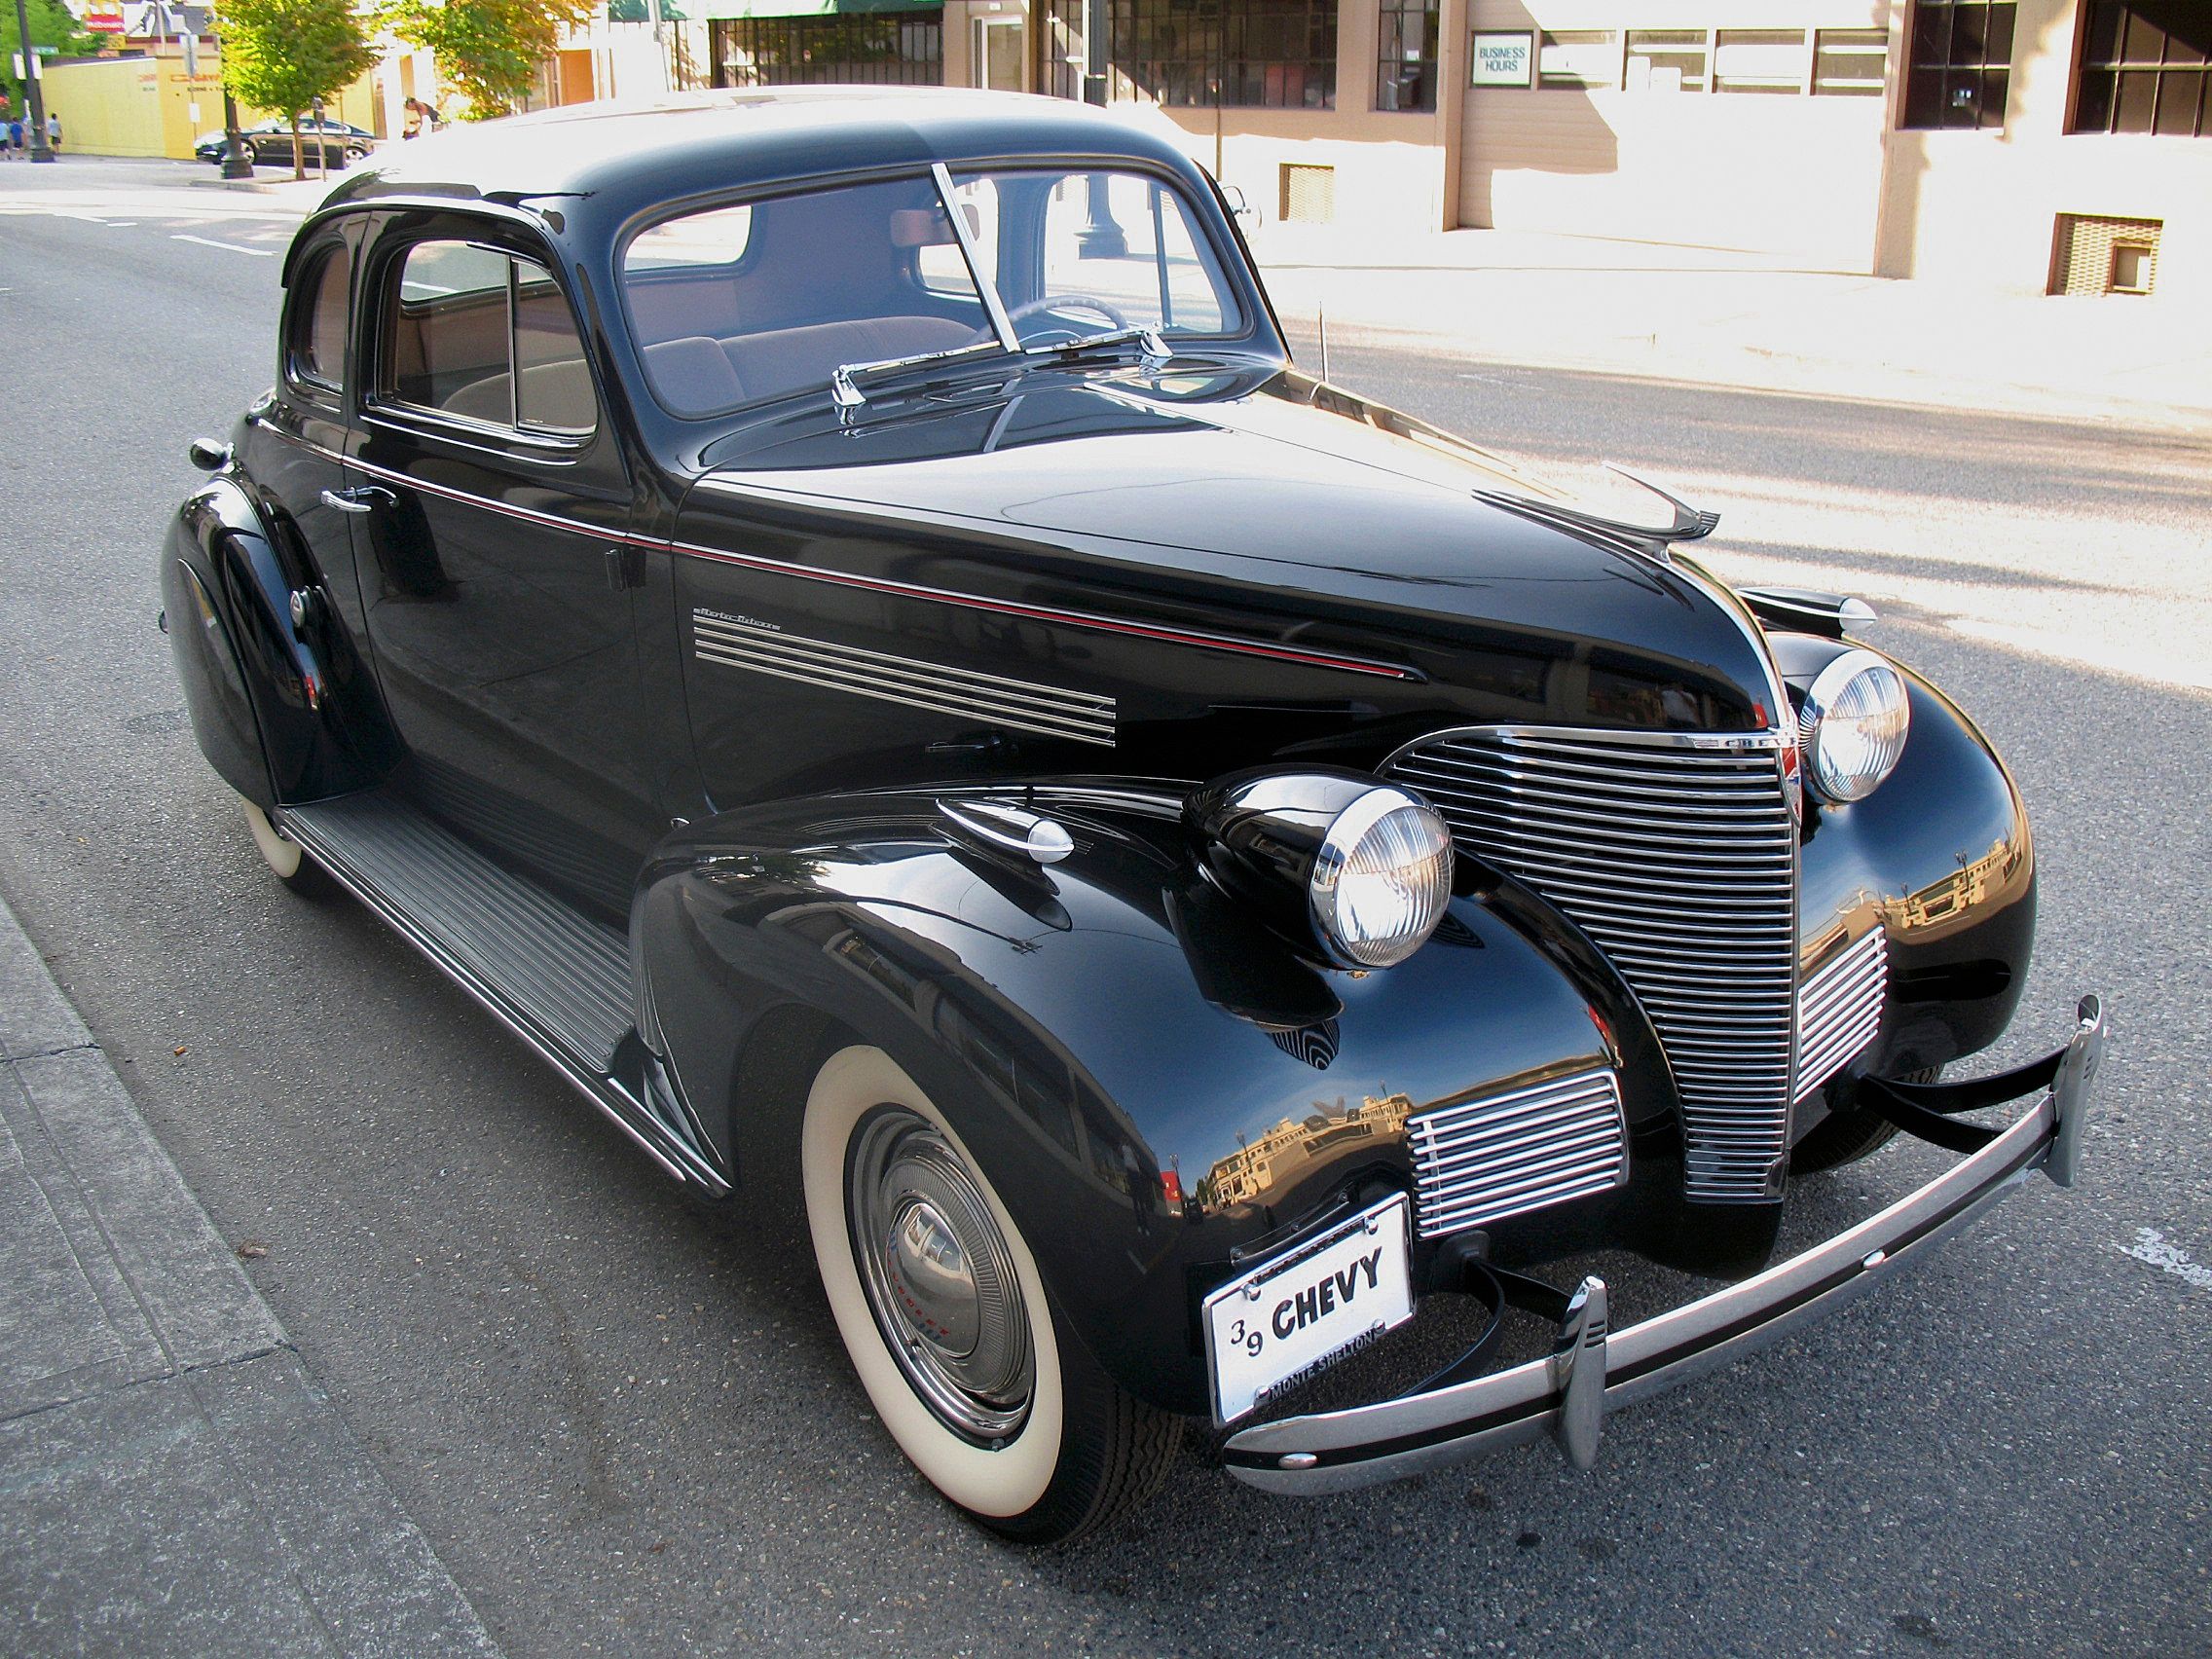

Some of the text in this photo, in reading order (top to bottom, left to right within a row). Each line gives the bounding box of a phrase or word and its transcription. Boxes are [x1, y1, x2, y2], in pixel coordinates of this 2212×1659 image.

[1479, 46, 1526, 58] BUSINESS
[1485, 59, 1519, 72] HOURS
[1272, 1245, 1382, 1340] CHEVY
[1270, 1328, 1378, 1400] MONTE SHELTON
